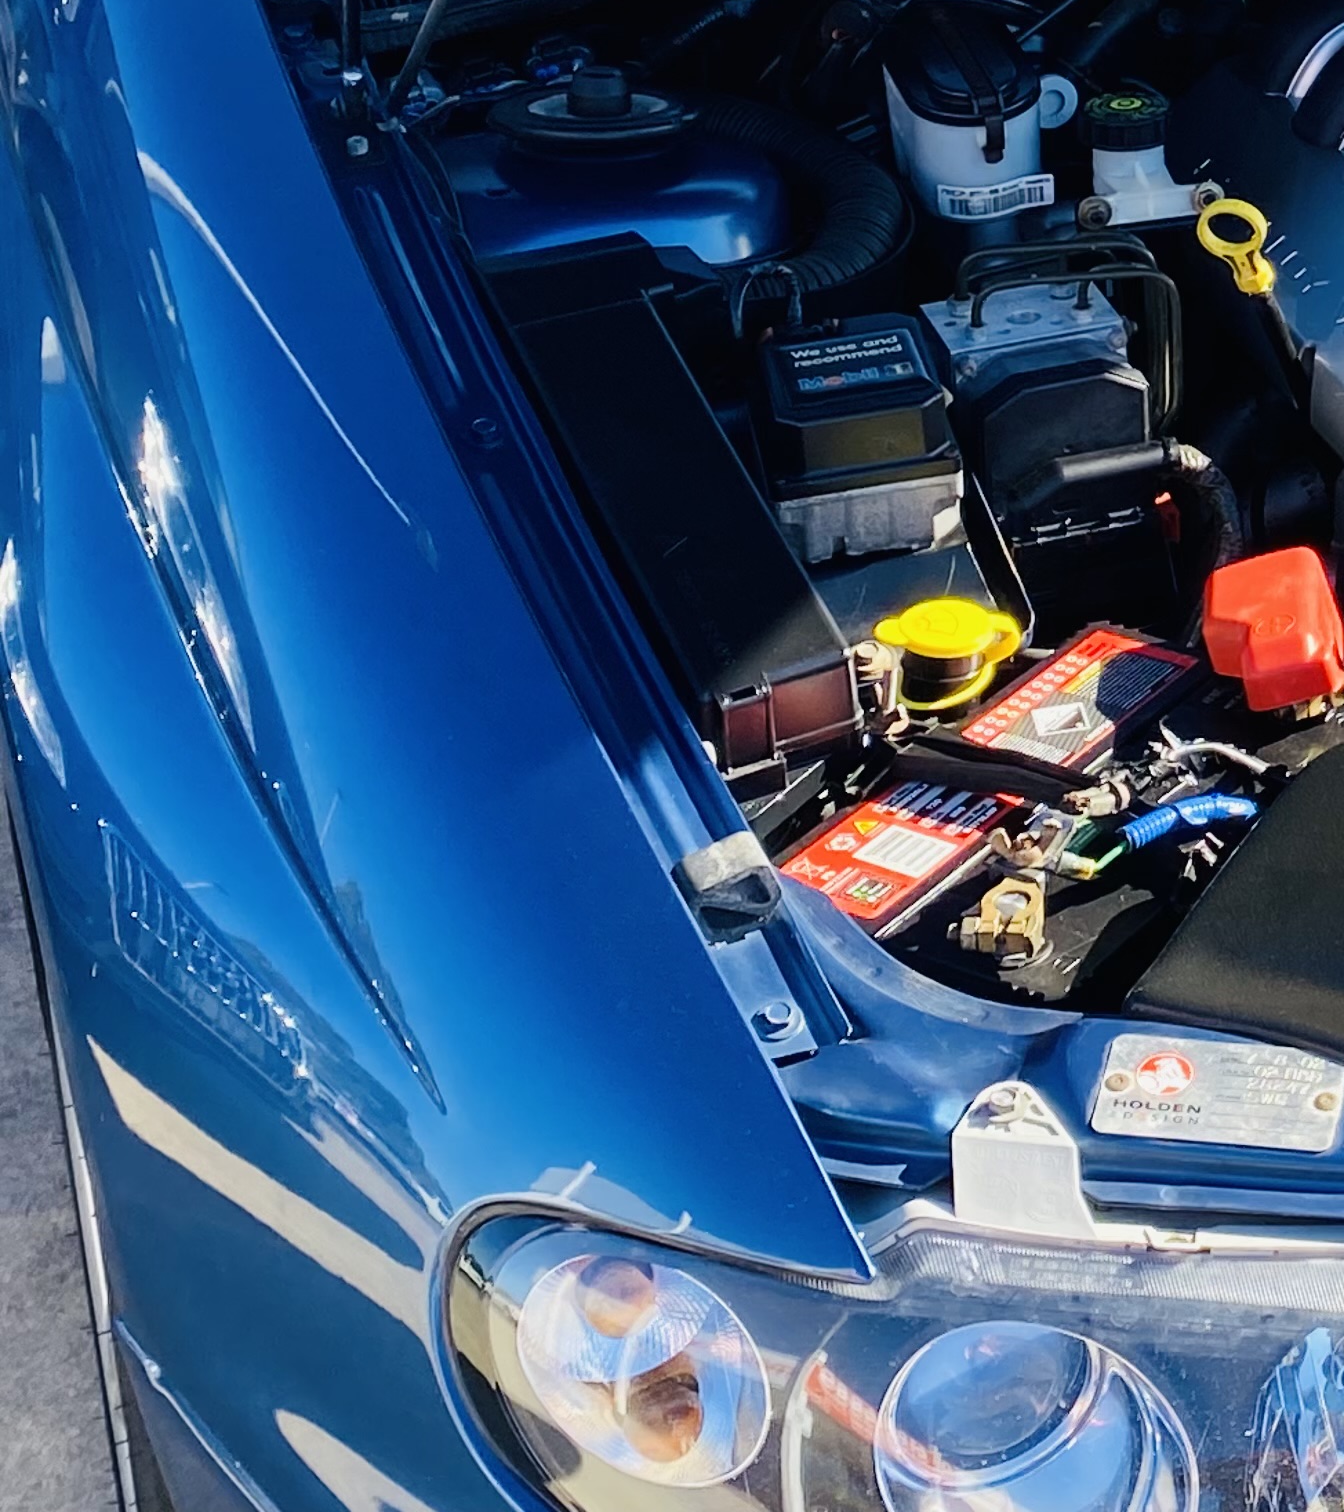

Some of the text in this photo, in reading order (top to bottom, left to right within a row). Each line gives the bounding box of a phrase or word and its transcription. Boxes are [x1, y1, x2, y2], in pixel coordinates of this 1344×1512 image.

[790, 335, 898, 359] We use and
[794, 344, 903, 367] recommend
[797, 366, 879, 391] Mobil
[1112, 1098, 1201, 1114] HOLDEN
